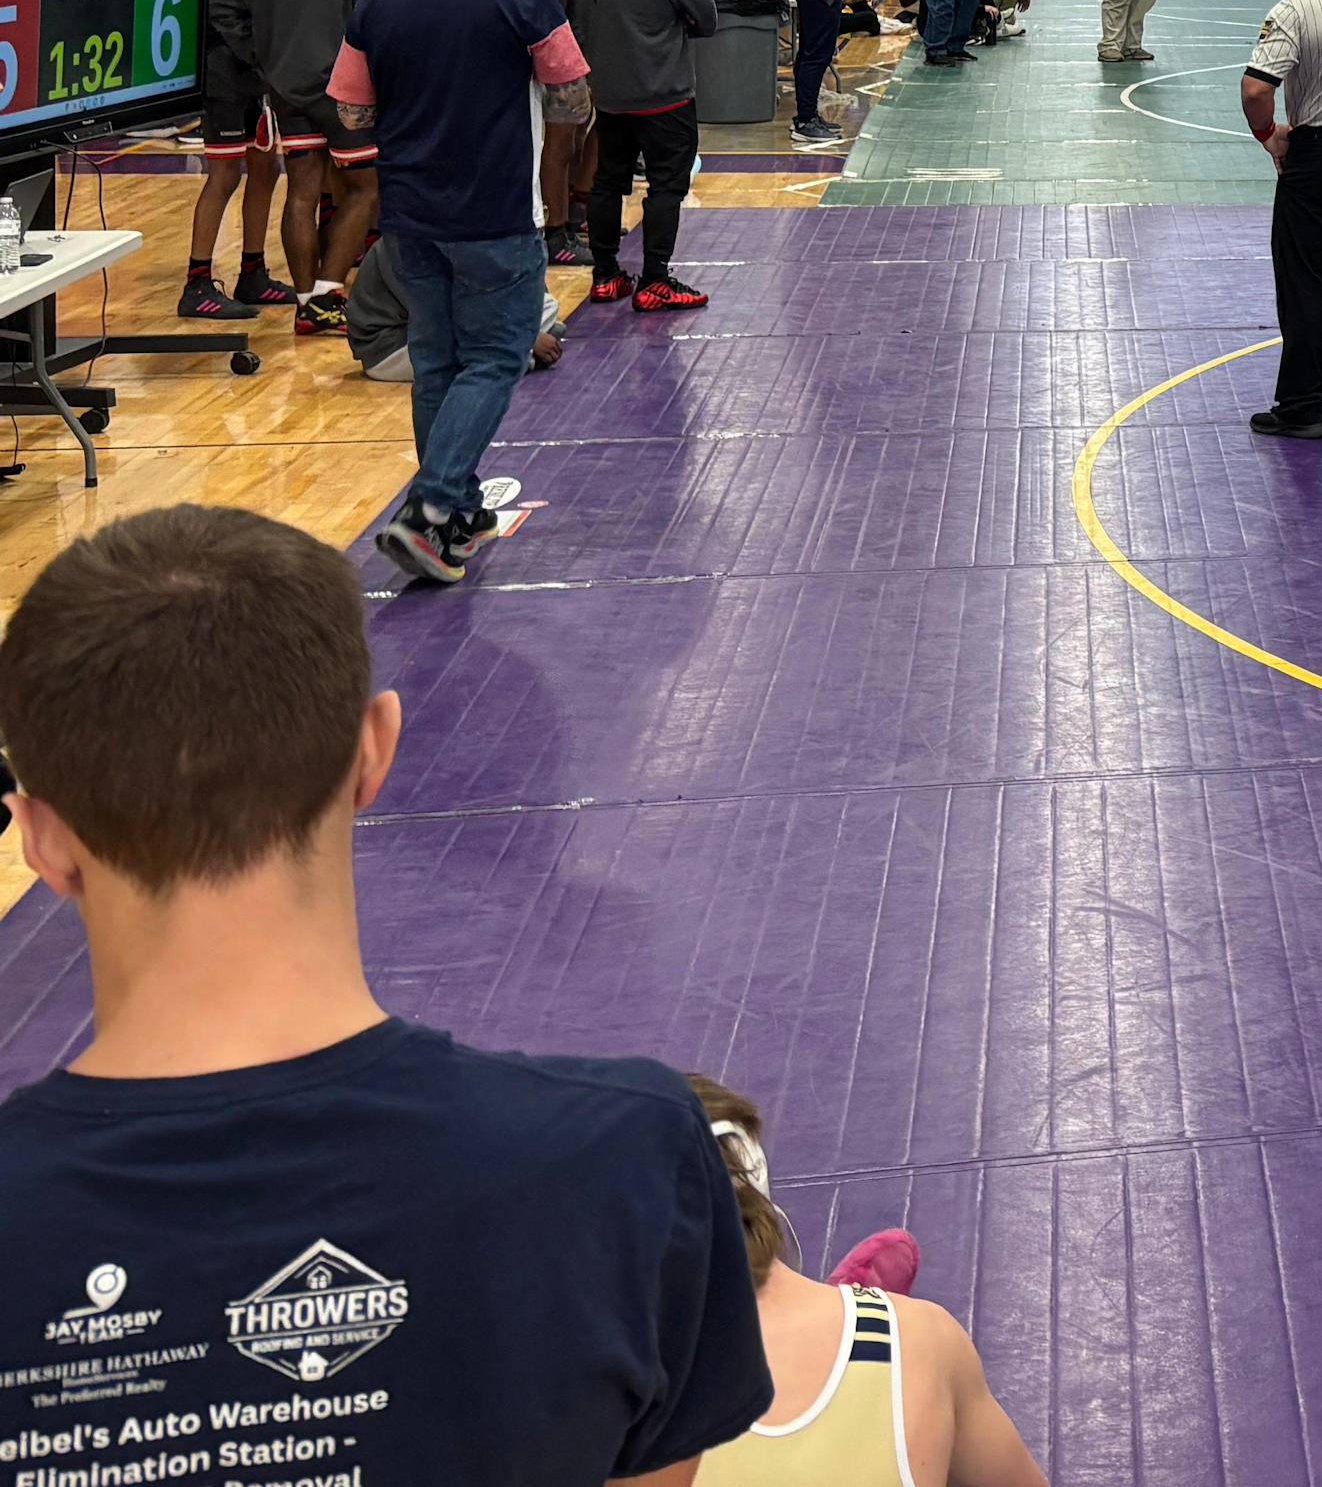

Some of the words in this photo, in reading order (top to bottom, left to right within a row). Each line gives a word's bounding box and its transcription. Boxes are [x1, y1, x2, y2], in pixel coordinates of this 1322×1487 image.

[49, 31, 124, 101] 1:32
[44, 1319, 85, 1341] JAY
[87, 1308, 163, 1334] MOSBY
[224, 1286, 409, 1336] THROWERS
[79, 1326, 125, 1345] TEAM
[251, 1336, 304, 1354] ROOFING
[305, 1333, 330, 1347] AND
[332, 1327, 381, 1345] SERVICE
[0, 1359, 103, 1388] ERKSHIRE
[107, 1342, 210, 1371] HATHAWAY
[0, 1424, 111, 1462] eibel's
[118, 1413, 201, 1446] Auto
[208, 1389, 389, 1431] Warehouse
[14, 1450, 211, 1487] Elimination
[218, 1435, 337, 1468] Station
